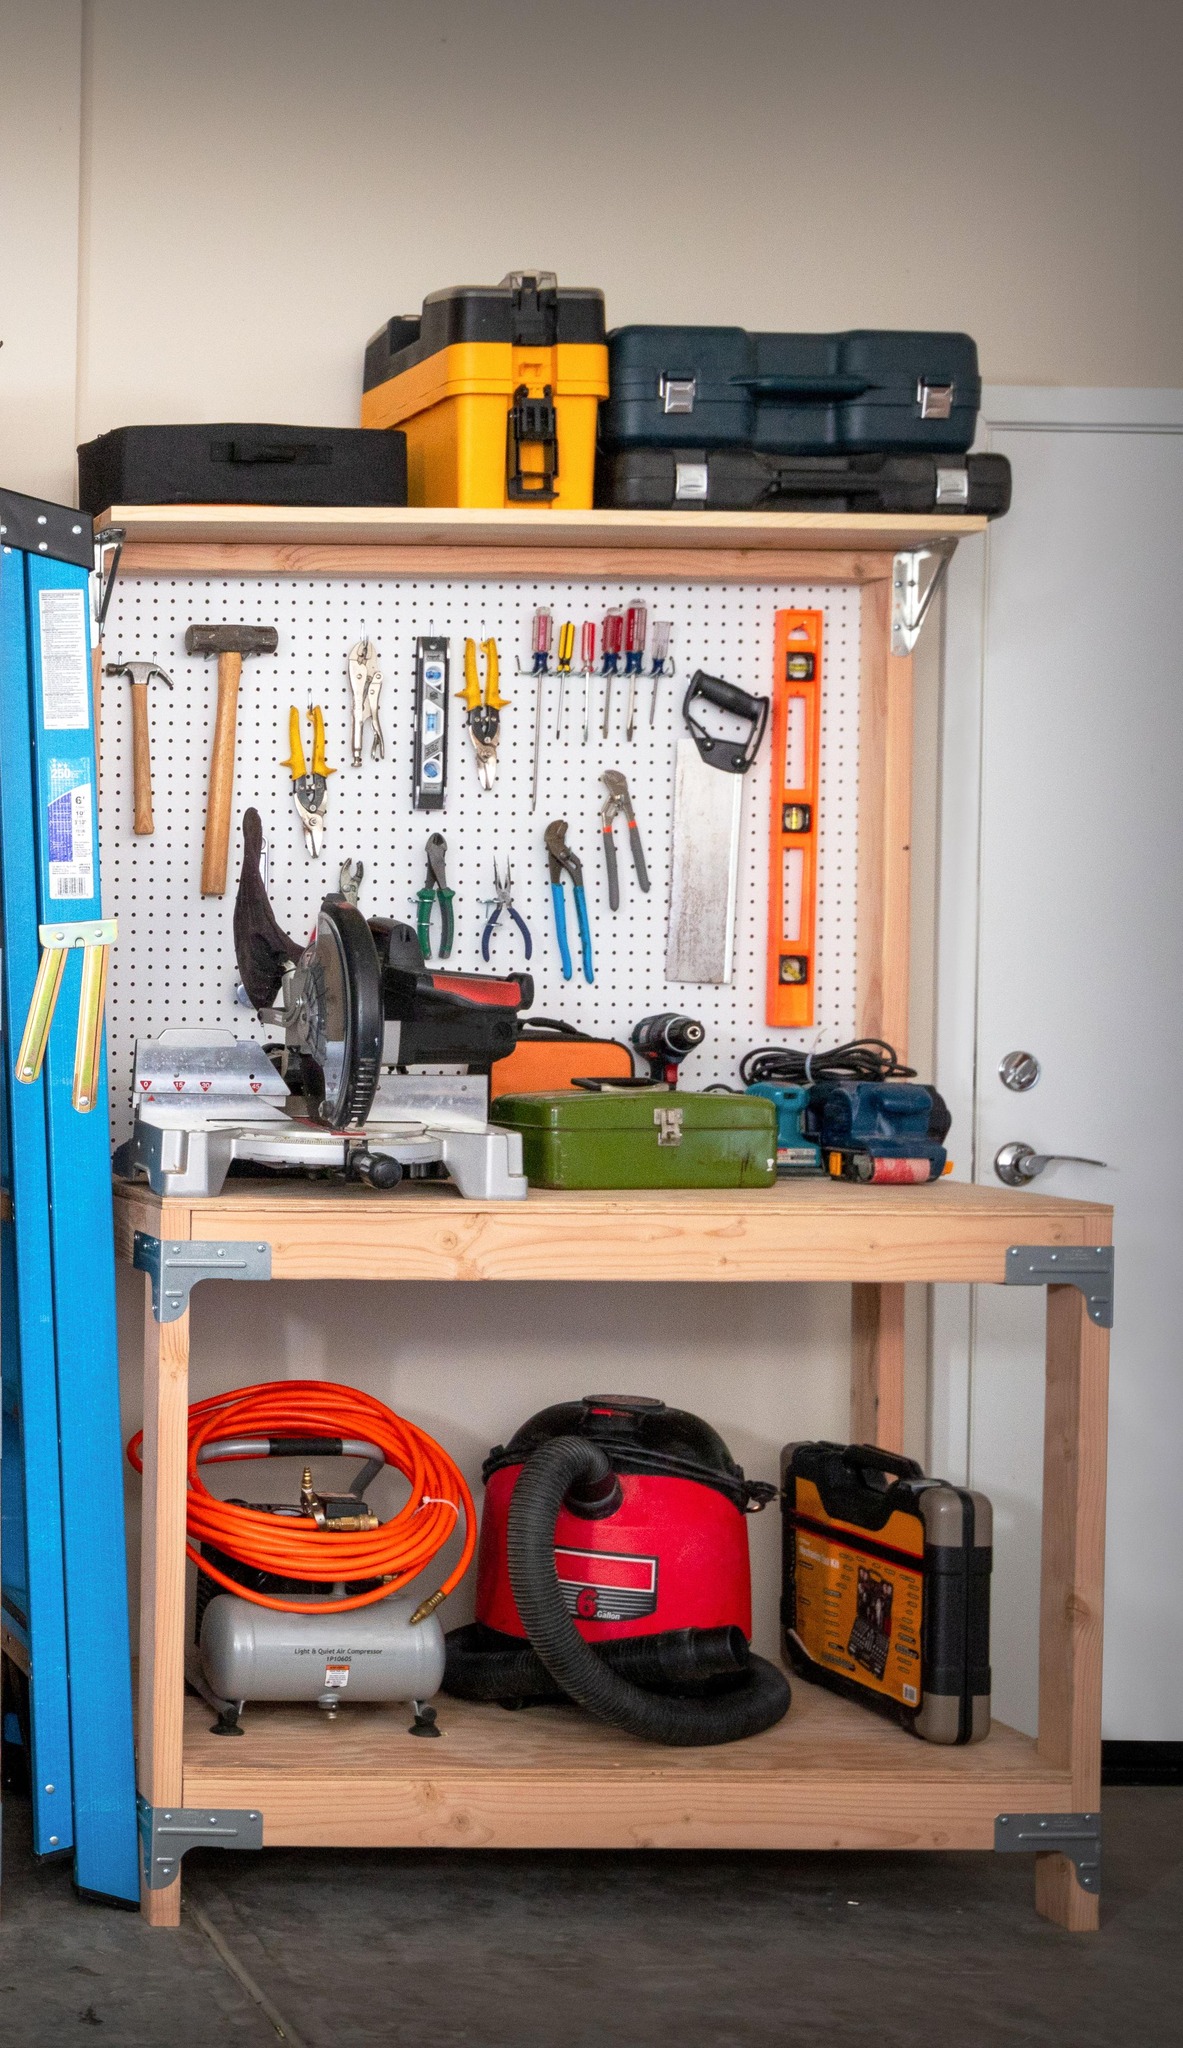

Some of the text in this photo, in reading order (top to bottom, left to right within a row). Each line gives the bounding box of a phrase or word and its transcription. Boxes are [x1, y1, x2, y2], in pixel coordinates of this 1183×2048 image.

[51, 769, 70, 779] 250
[577, 1588, 620, 1620] 6 Gallon
[318, 1648, 335, 1656] Quiet
